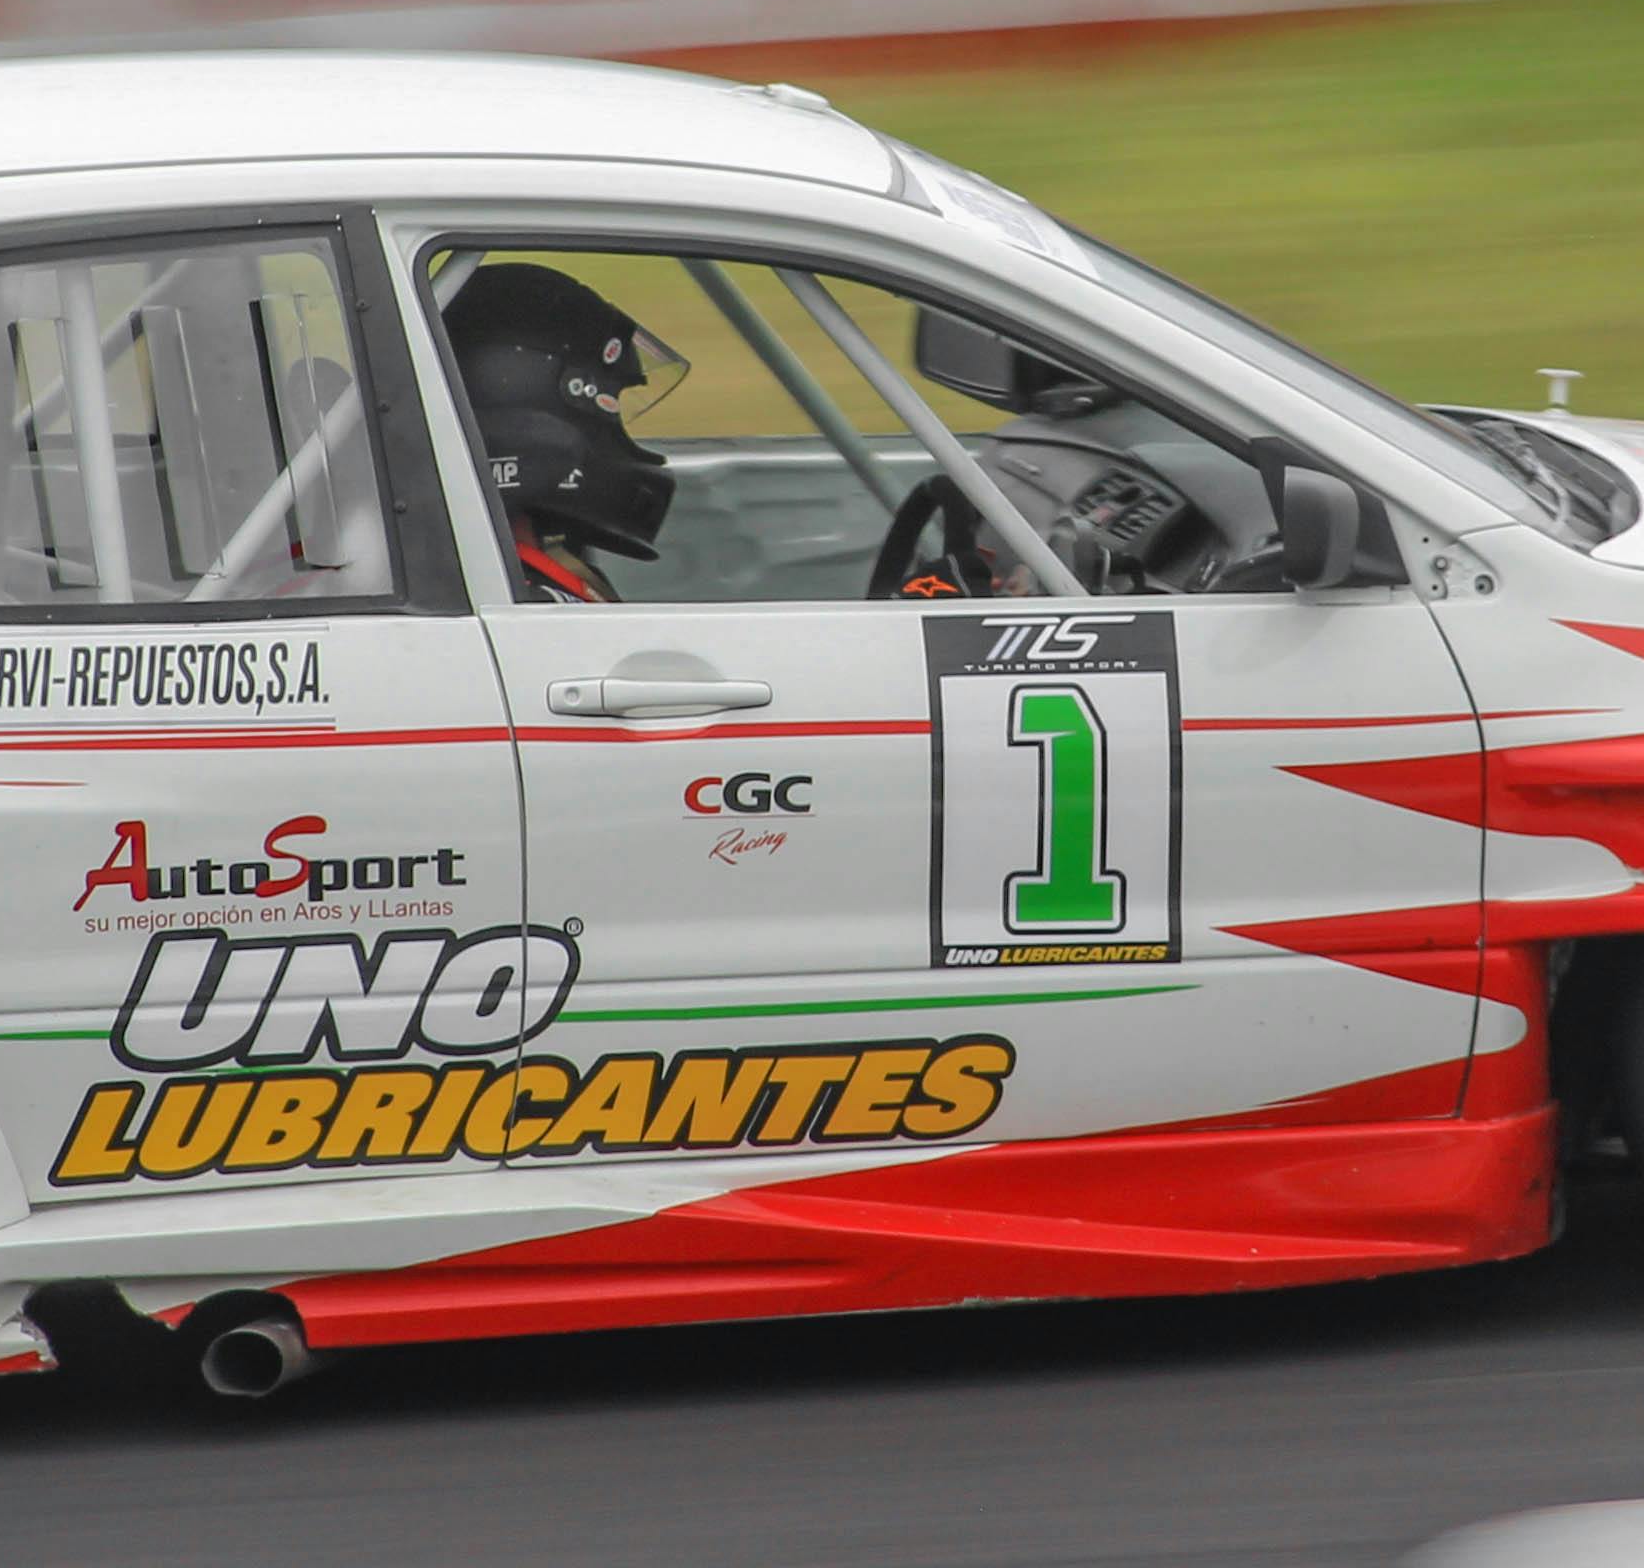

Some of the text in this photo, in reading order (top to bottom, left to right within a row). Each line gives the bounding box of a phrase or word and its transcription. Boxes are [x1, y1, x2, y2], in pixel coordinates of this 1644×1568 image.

[964, 661, 1139, 672] TURISMO SPORT
[684, 772, 813, 814] CGC
[1003, 683, 1127, 935] 1
[708, 828, 788, 865] Racing
[84, 898, 454, 935] su mejor opción en Aros y LLantas
[945, 944, 1170, 966] UNO LUBRICANTES
[108, 923, 582, 1073] UNO
[48, 1033, 1017, 1188] LUBRICANTES
